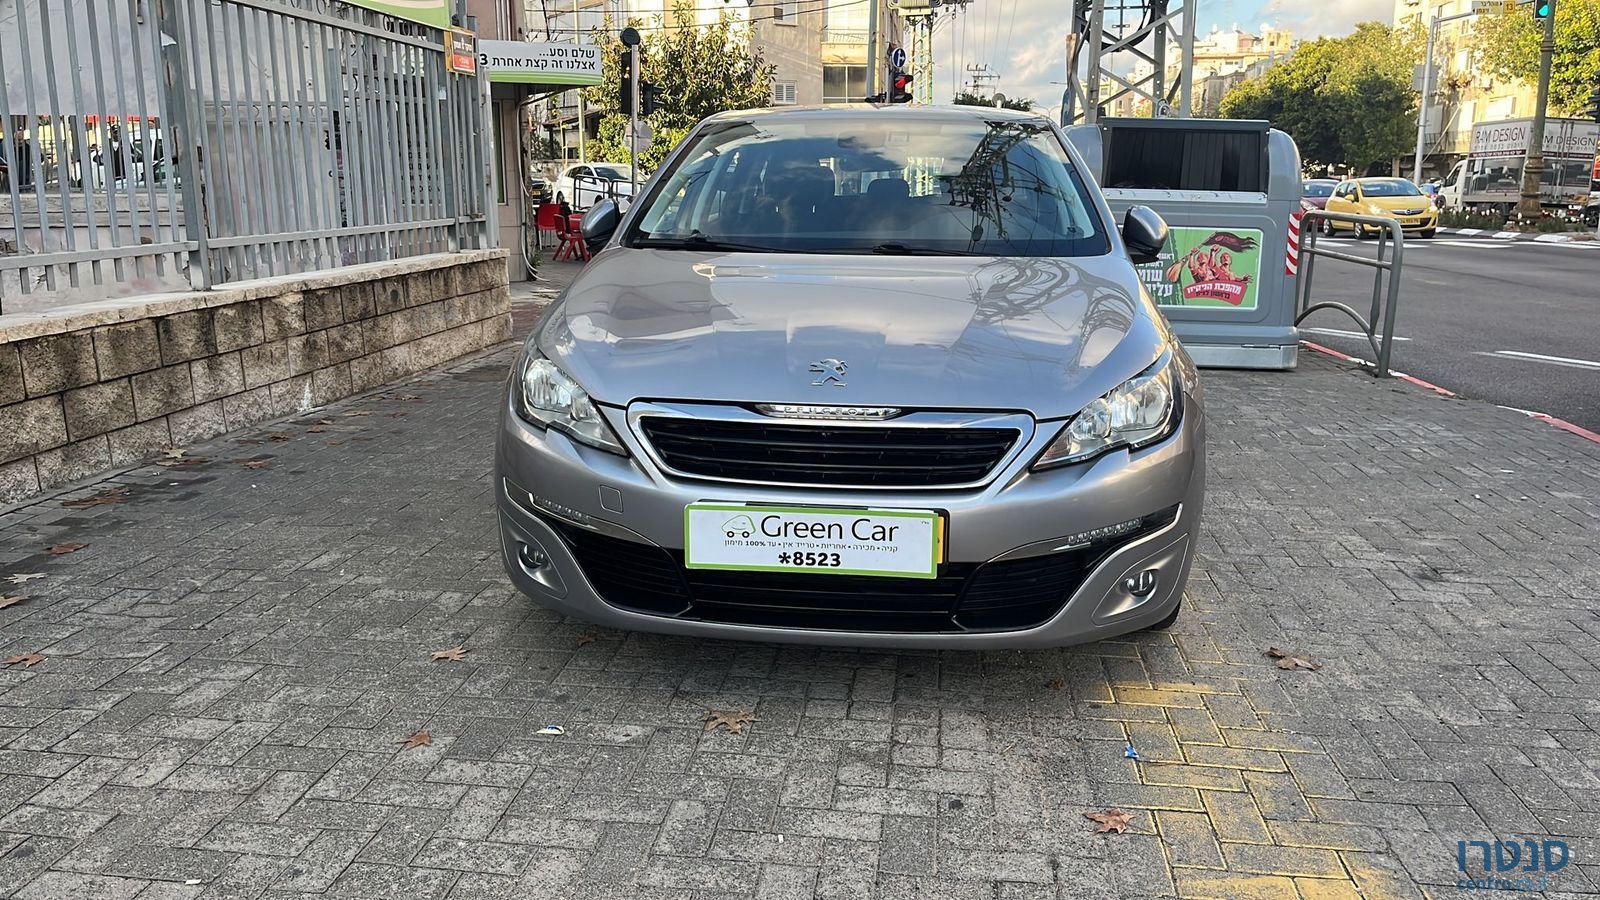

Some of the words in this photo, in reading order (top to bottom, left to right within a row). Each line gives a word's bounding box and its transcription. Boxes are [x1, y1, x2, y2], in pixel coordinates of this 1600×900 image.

[1506, 3, 1513, 11] 13
[539, 48, 568, 57] וסע...
[572, 48, 595, 58] שלם
[492, 57, 522, 67] אחרת
[526, 58, 548, 70] קצת
[551, 59, 563, 68] זה
[566, 59, 595, 70] אצלנו
[1493, 127, 1526, 143] DESIGN
[1138, 269, 1163, 281] שומ
[784, 406, 869, 417] PEUGEOT
[761, 515, 843, 540] Green
[851, 519, 899, 542] Car
